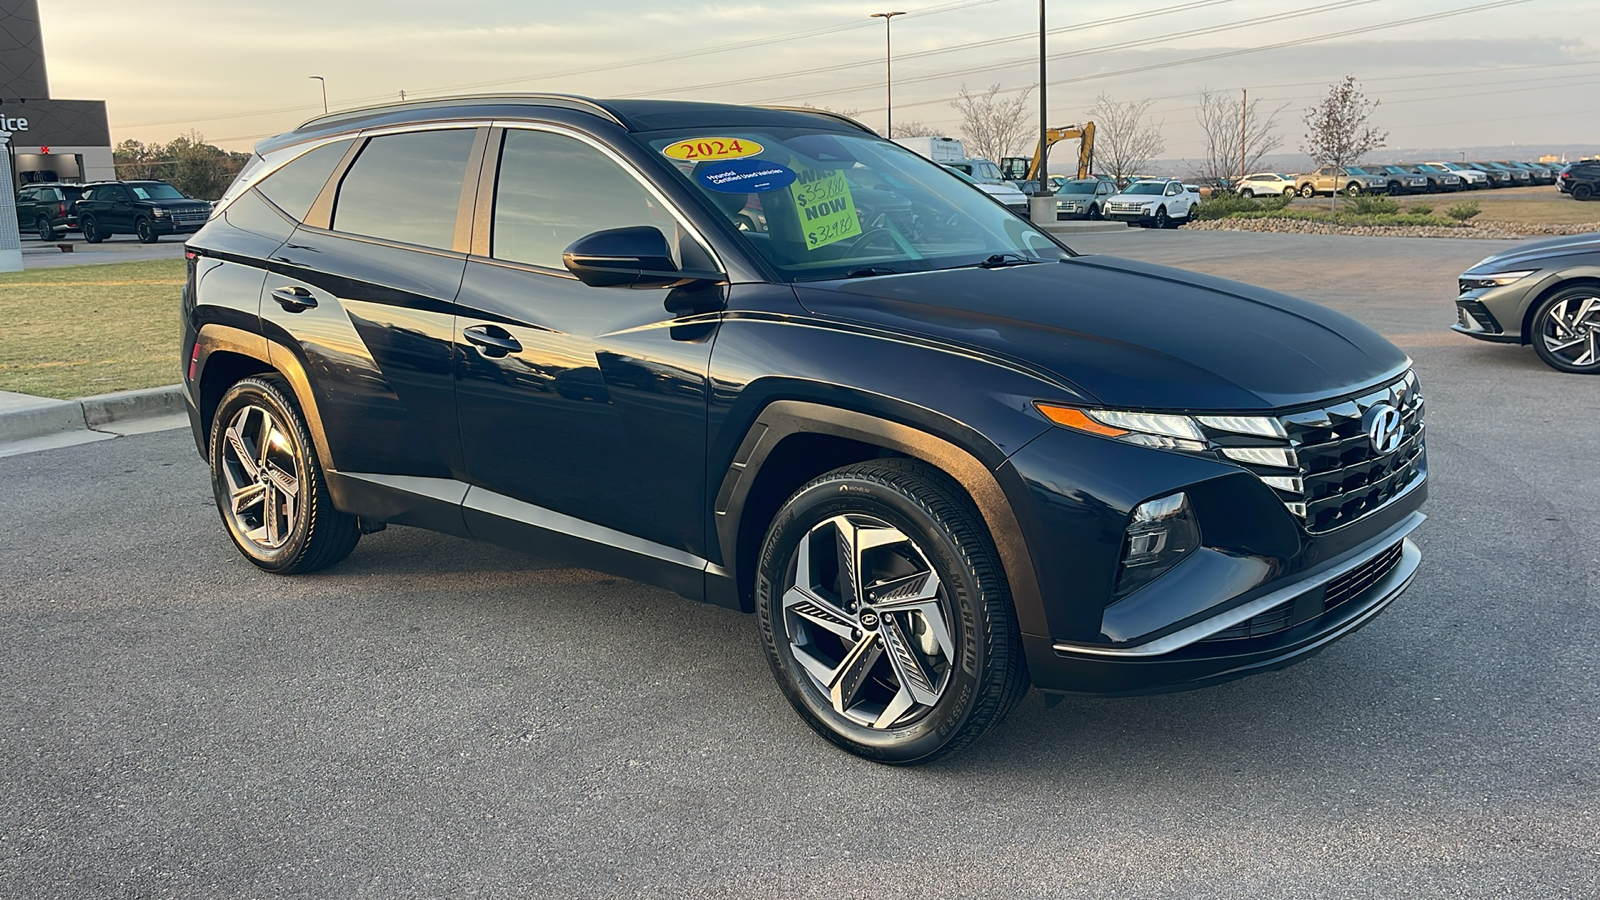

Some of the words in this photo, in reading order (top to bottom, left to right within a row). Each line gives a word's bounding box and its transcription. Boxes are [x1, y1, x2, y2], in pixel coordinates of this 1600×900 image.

[0, 113, 29, 131] ice
[680, 139, 743, 159] 2024
[713, 174, 743, 184] Certified
[804, 197, 847, 221] NOW
[762, 524, 785, 569] PRIMACY
[758, 580, 784, 668] MICHELIN
[950, 573, 977, 672] MICHELIN
